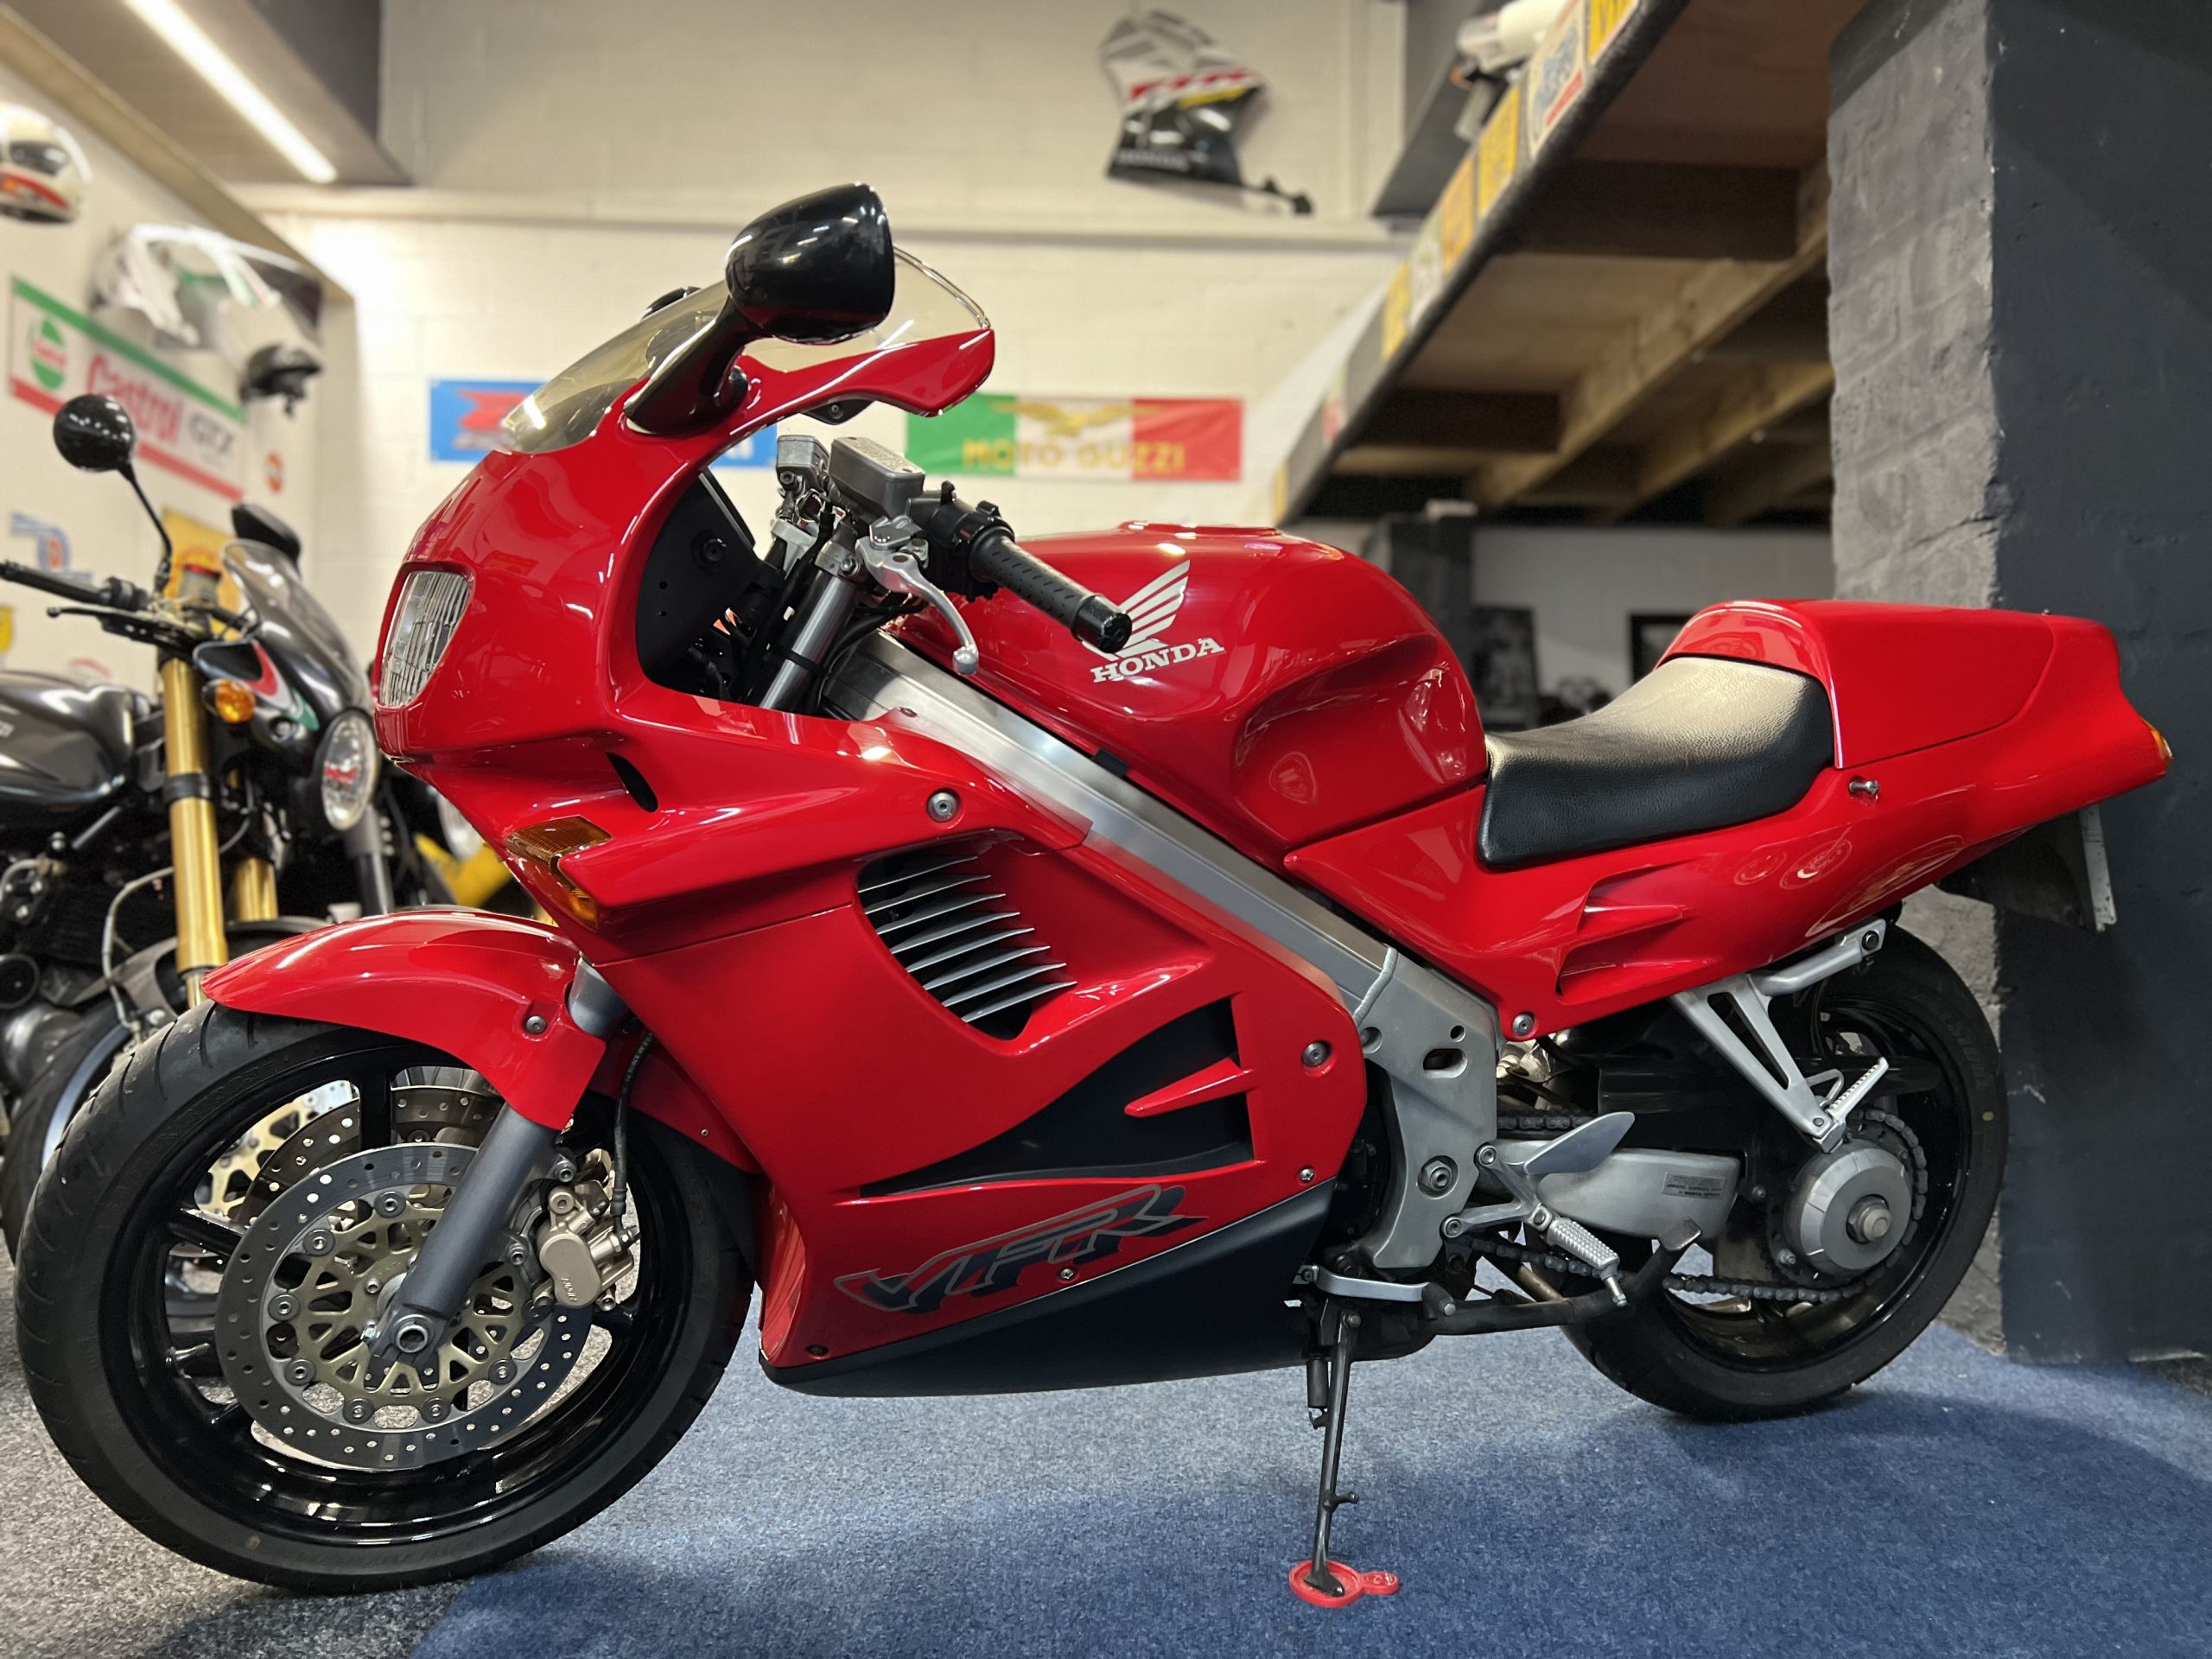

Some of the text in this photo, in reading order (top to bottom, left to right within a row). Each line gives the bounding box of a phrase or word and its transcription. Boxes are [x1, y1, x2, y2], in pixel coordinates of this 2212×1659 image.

[962, 438, 1186, 474] MOTO GUZZI
[1090, 637, 1225, 683] HONDA
[832, 1183, 1209, 1315] VFR
